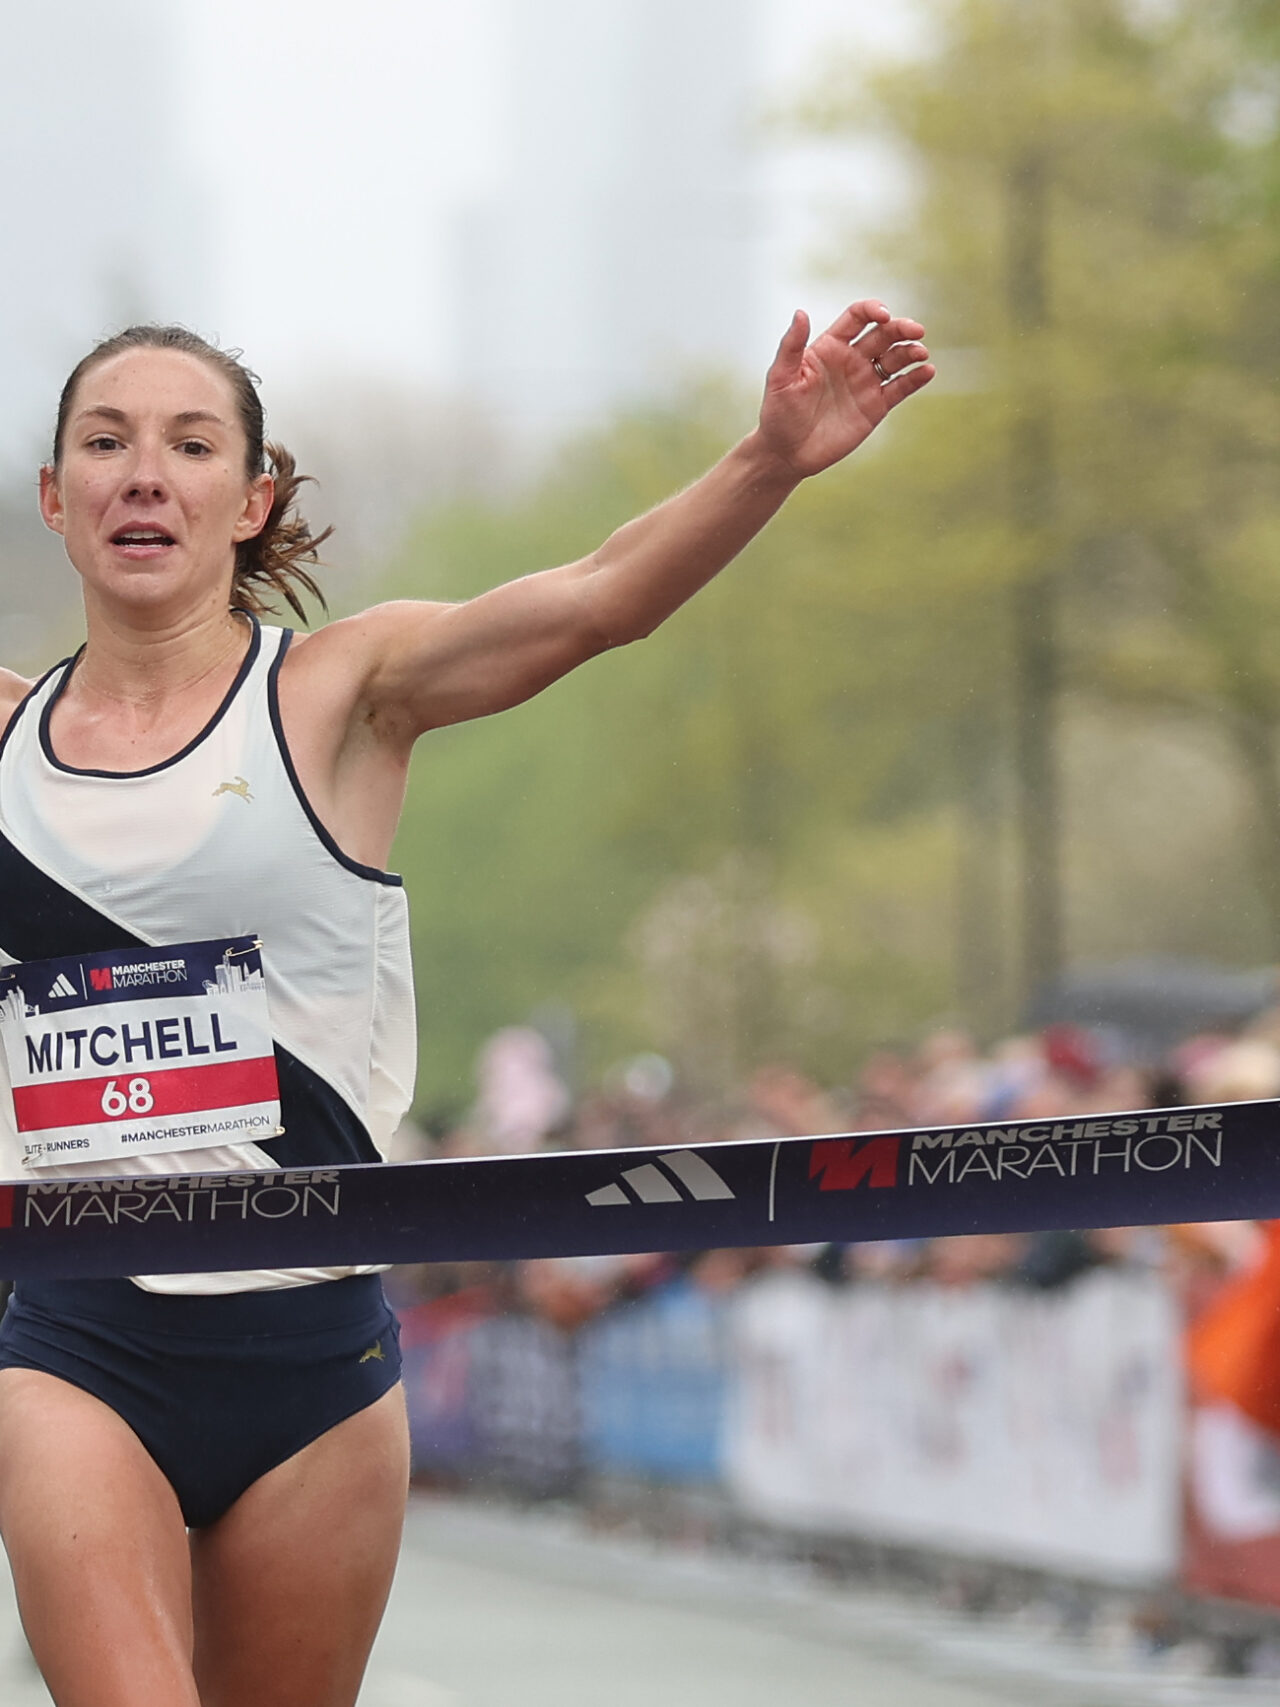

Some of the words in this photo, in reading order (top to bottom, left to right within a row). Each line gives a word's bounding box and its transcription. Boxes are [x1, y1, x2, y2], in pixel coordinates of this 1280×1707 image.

[112, 959, 186, 976] MANCHESTER
[112, 969, 188, 989] MARATHON
[25, 1013, 238, 1074] MITCHELL
[101, 1077, 155, 1118] 68
[121, 1115, 270, 1143] #MANCHESTERMARATHON
[912, 1112, 1223, 1151] MANCHESTER
[908, 1131, 1223, 1186] MARATHON
[28, 1170, 340, 1194] MANCHESTER
[24, 1184, 340, 1227] MARATHON
